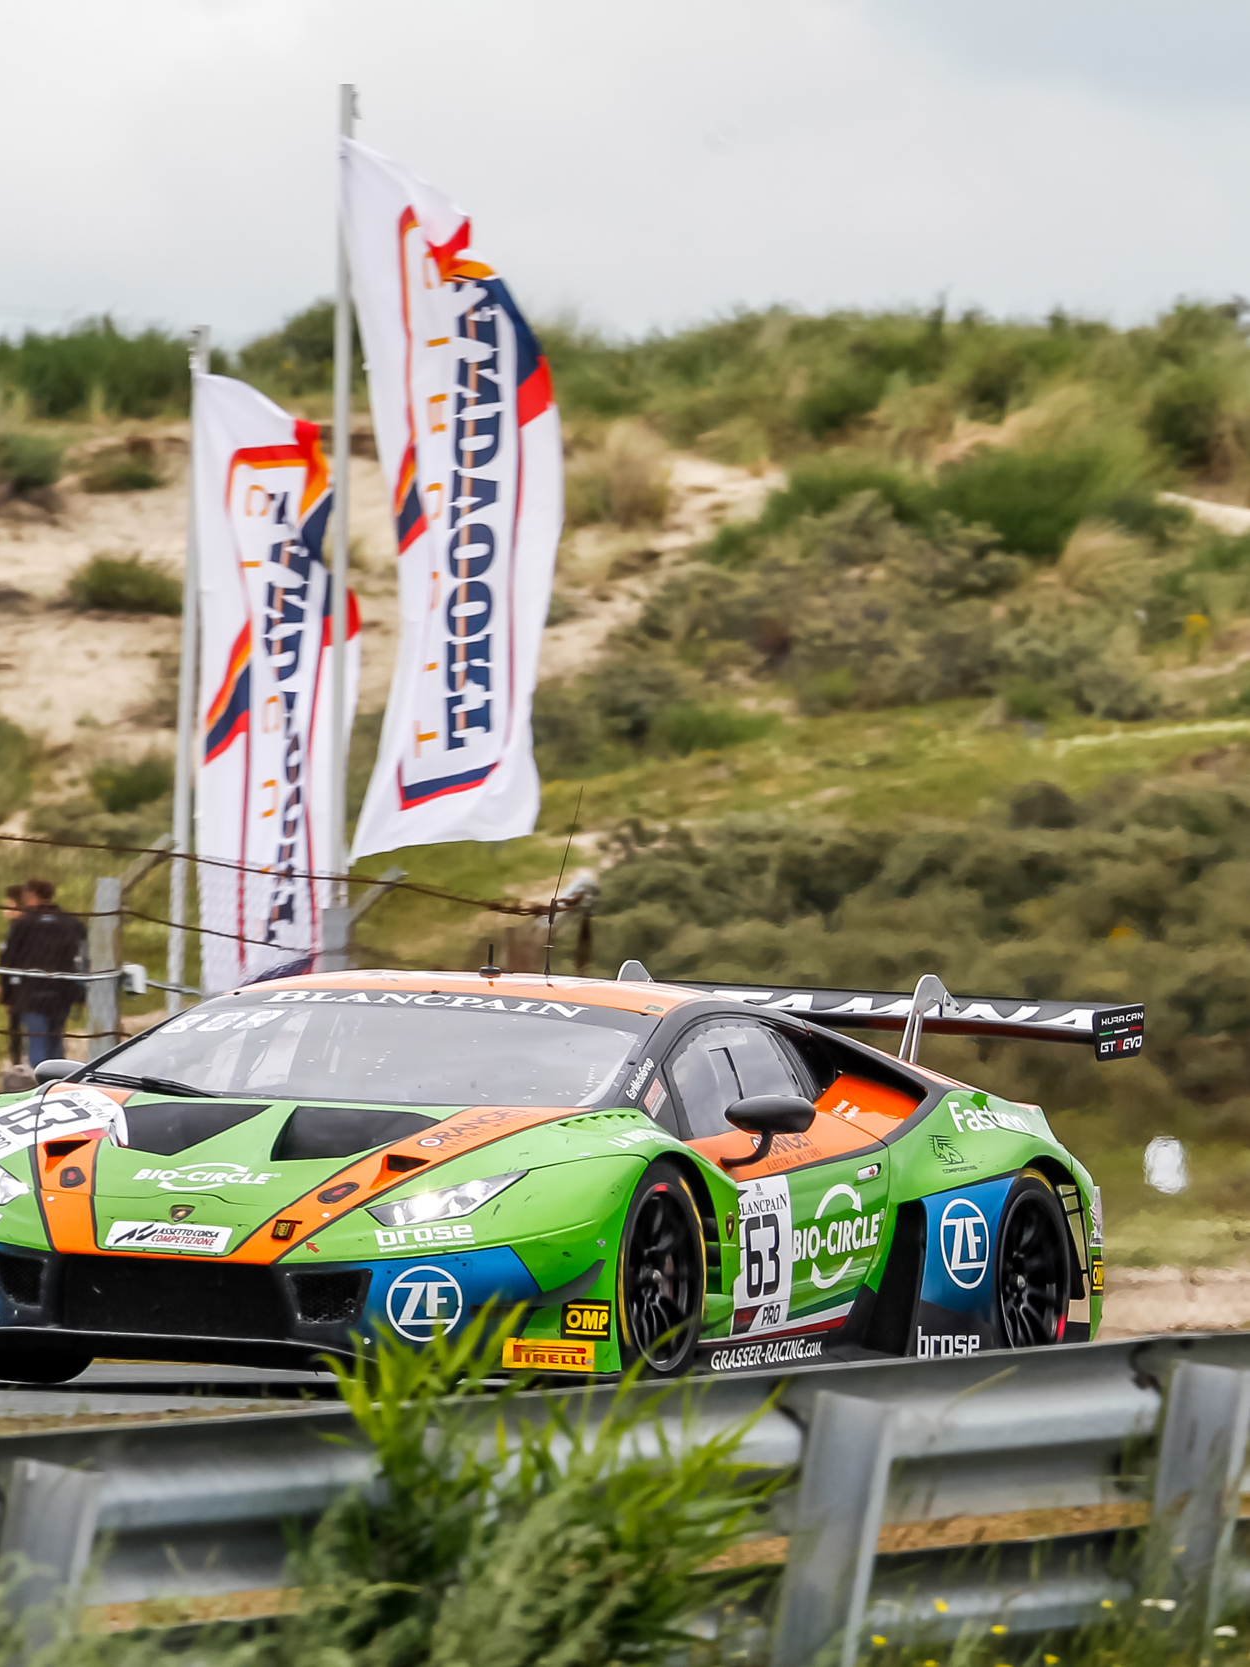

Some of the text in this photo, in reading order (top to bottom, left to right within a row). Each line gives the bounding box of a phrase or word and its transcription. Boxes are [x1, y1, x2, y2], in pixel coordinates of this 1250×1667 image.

[262, 990, 590, 1020] BLANCPAIN
[947, 1102, 1031, 1133] Fastron
[766, 1148, 822, 1171] ELECTRIC MOTORS
[132, 1169, 273, 1185] BIO-CIRCLE
[151, 1235, 216, 1246] COMPETIZIONE
[158, 1227, 219, 1238] ASSETTO CORSA
[374, 1224, 474, 1247] brose
[792, 1213, 880, 1264] BIO-CIRCLE
[745, 1213, 781, 1299] 63
[565, 1309, 609, 1330] OMP
[761, 1304, 781, 1326] PRO
[917, 1326, 980, 1359] brose
[513, 1344, 587, 1366] PIRELLI
